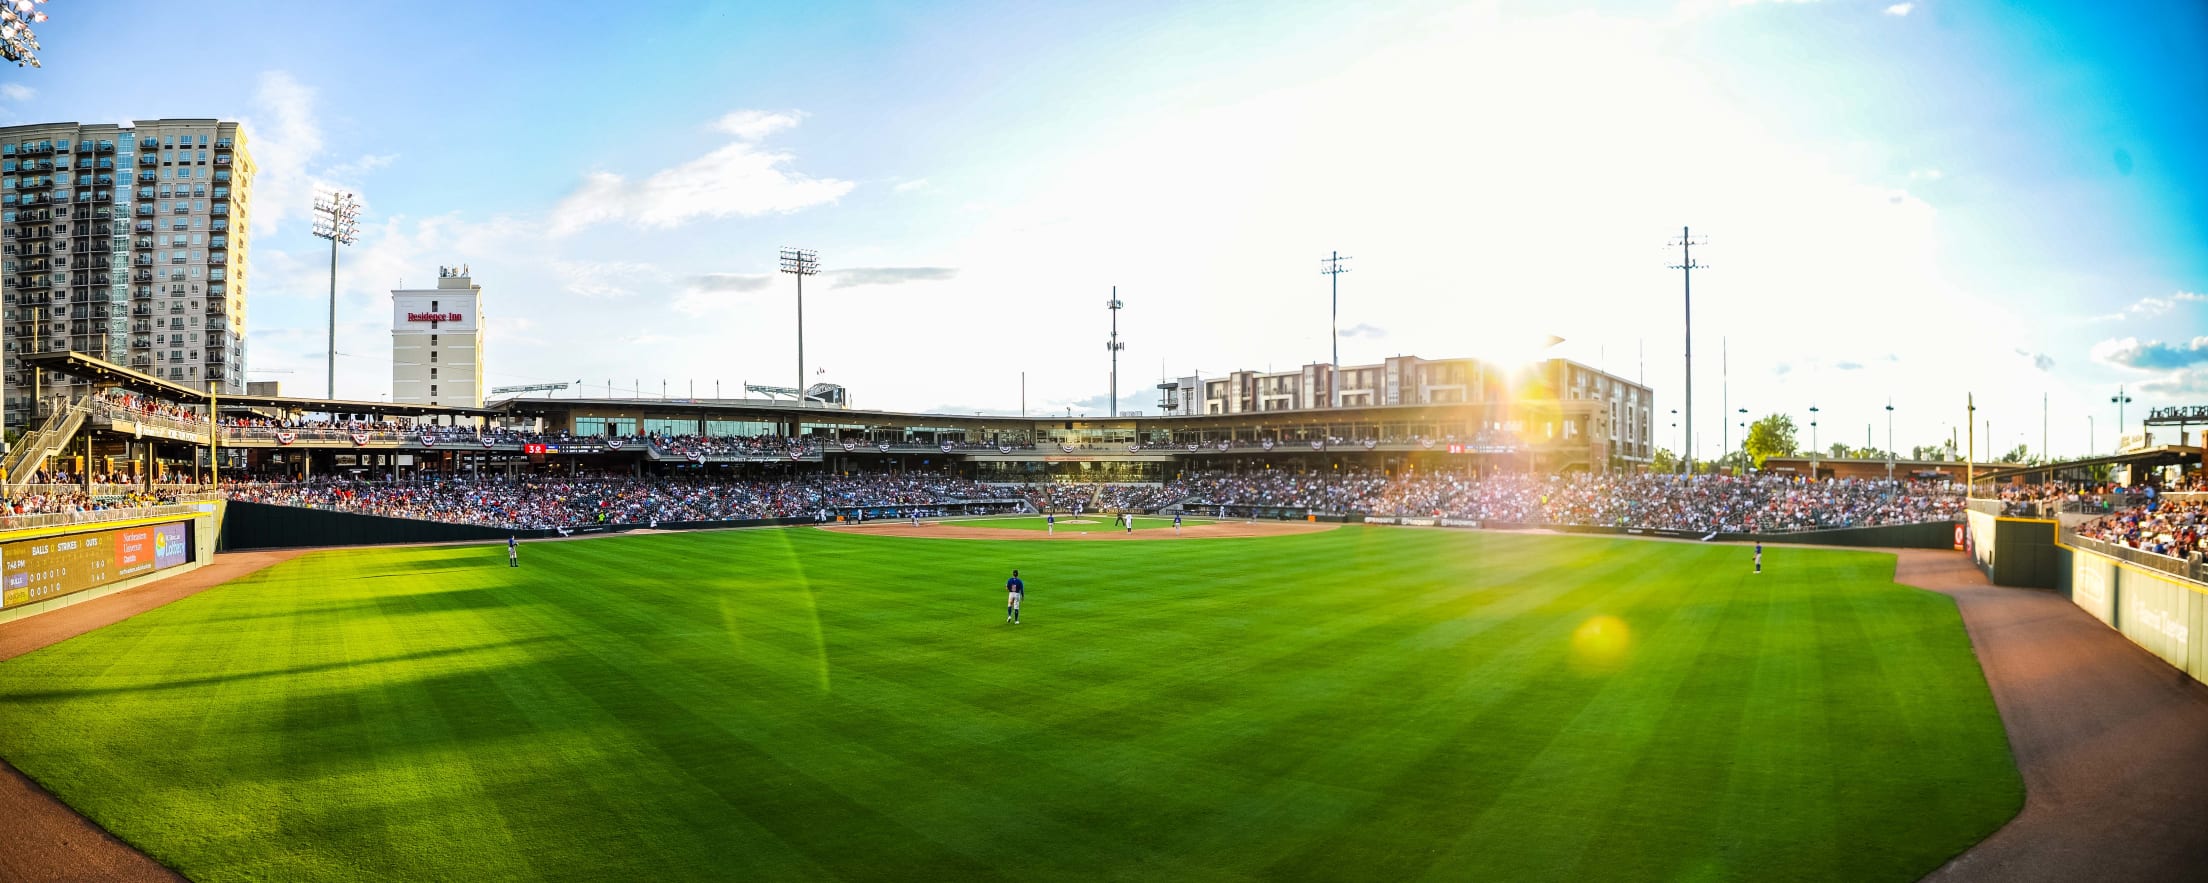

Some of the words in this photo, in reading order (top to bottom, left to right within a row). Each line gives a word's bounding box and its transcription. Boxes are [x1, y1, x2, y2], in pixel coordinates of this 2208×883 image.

[408, 312, 447, 321] Residence
[449, 312, 462, 321] Inn
[32, 545, 48, 556] BALLS
[57, 541, 77, 552] STRIKES
[85, 538, 98, 547] OUTS
[165, 541, 185, 557] Lottery
